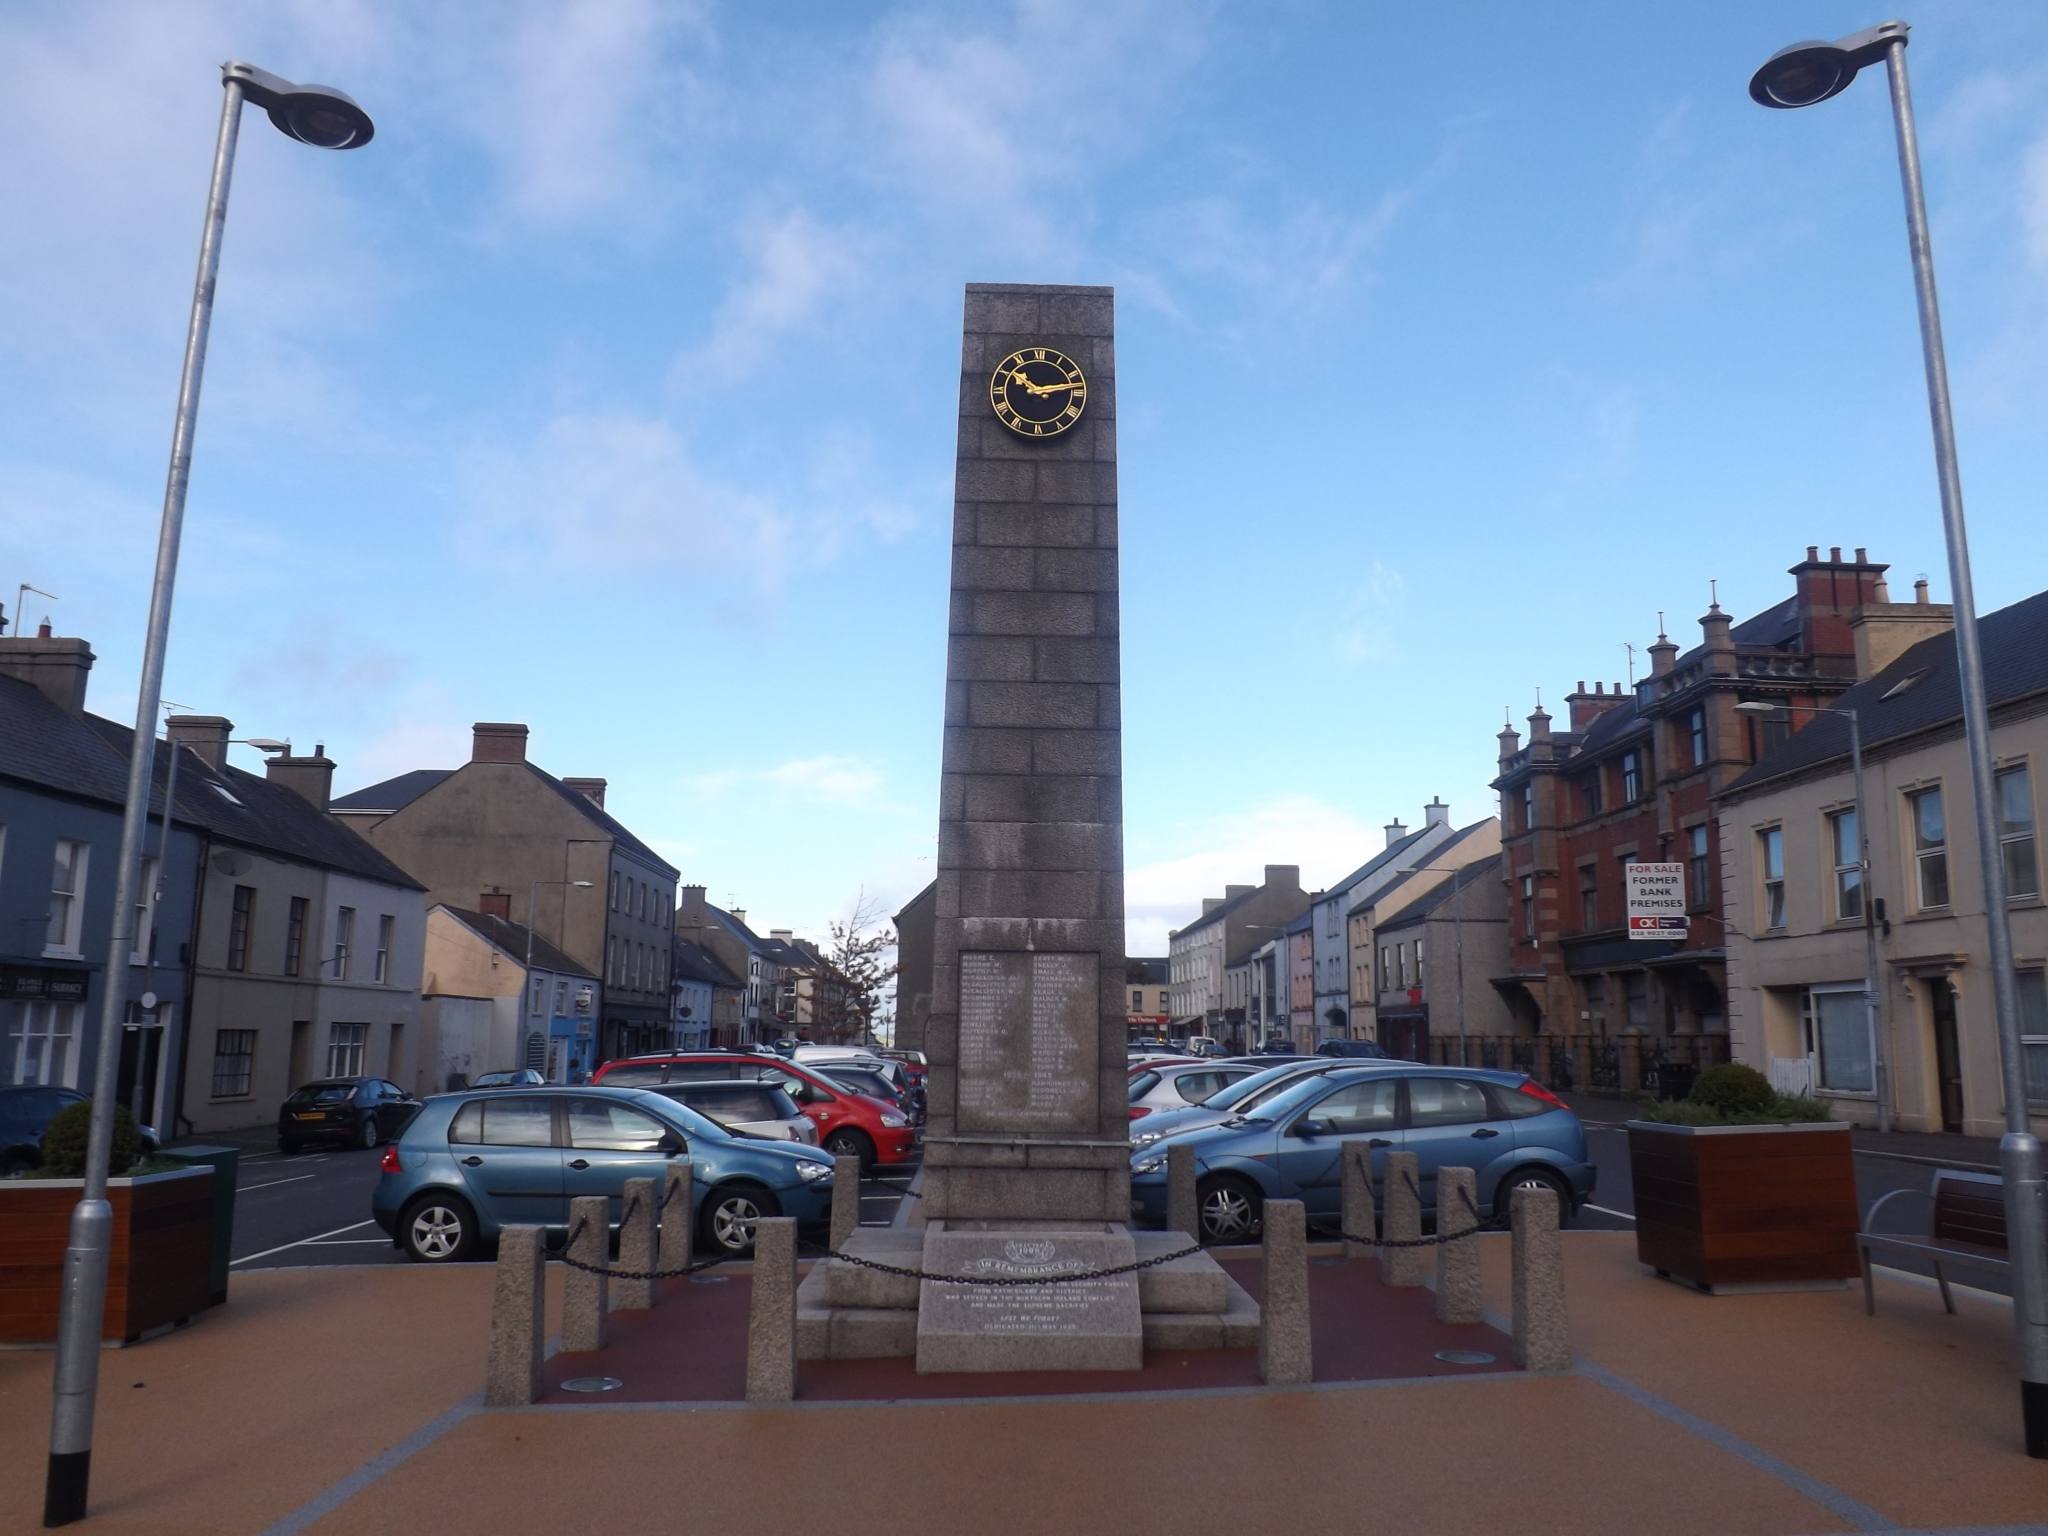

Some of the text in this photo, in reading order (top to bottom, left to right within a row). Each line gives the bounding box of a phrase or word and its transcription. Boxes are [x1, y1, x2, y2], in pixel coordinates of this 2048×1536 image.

[1629, 865, 1682, 873] FOR SALE
[1632, 876, 1679, 885] FORMER
[1640, 888, 1673, 896] BANK
[1630, 899, 1683, 907] PREMISES
[995, 1262, 1064, 1274] REMEMBRANCE
[1065, 1262, 1079, 1270] OF
